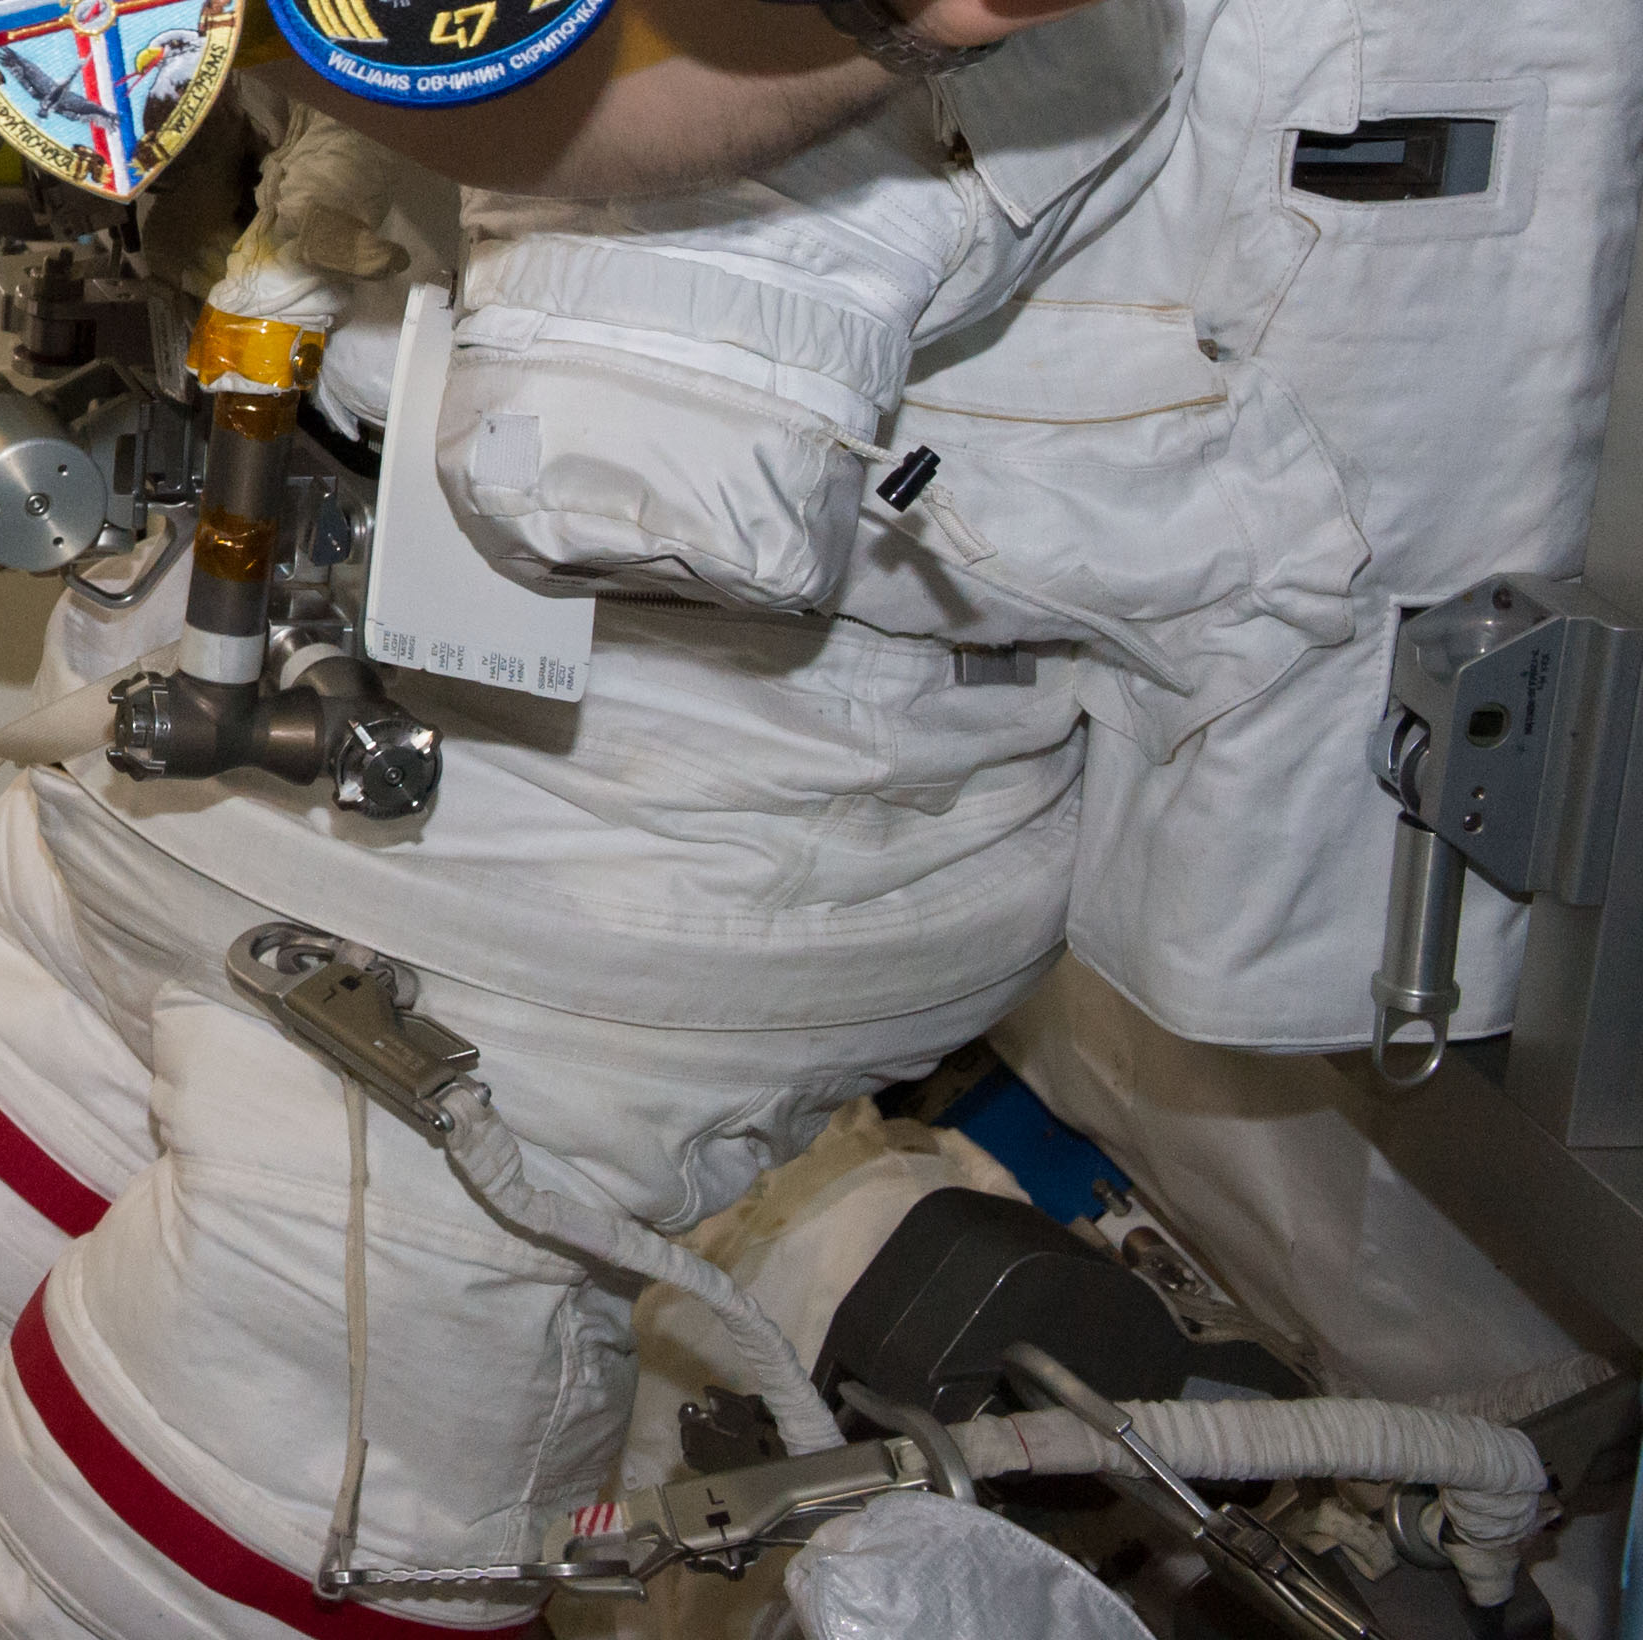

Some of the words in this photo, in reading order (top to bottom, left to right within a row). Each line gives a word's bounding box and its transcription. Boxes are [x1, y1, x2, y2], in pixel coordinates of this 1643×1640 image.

[429, 0, 497, 50] 47
[326, 49, 411, 92] WILLIAMS
[416, 61, 506, 93] ОВЧИНИН
